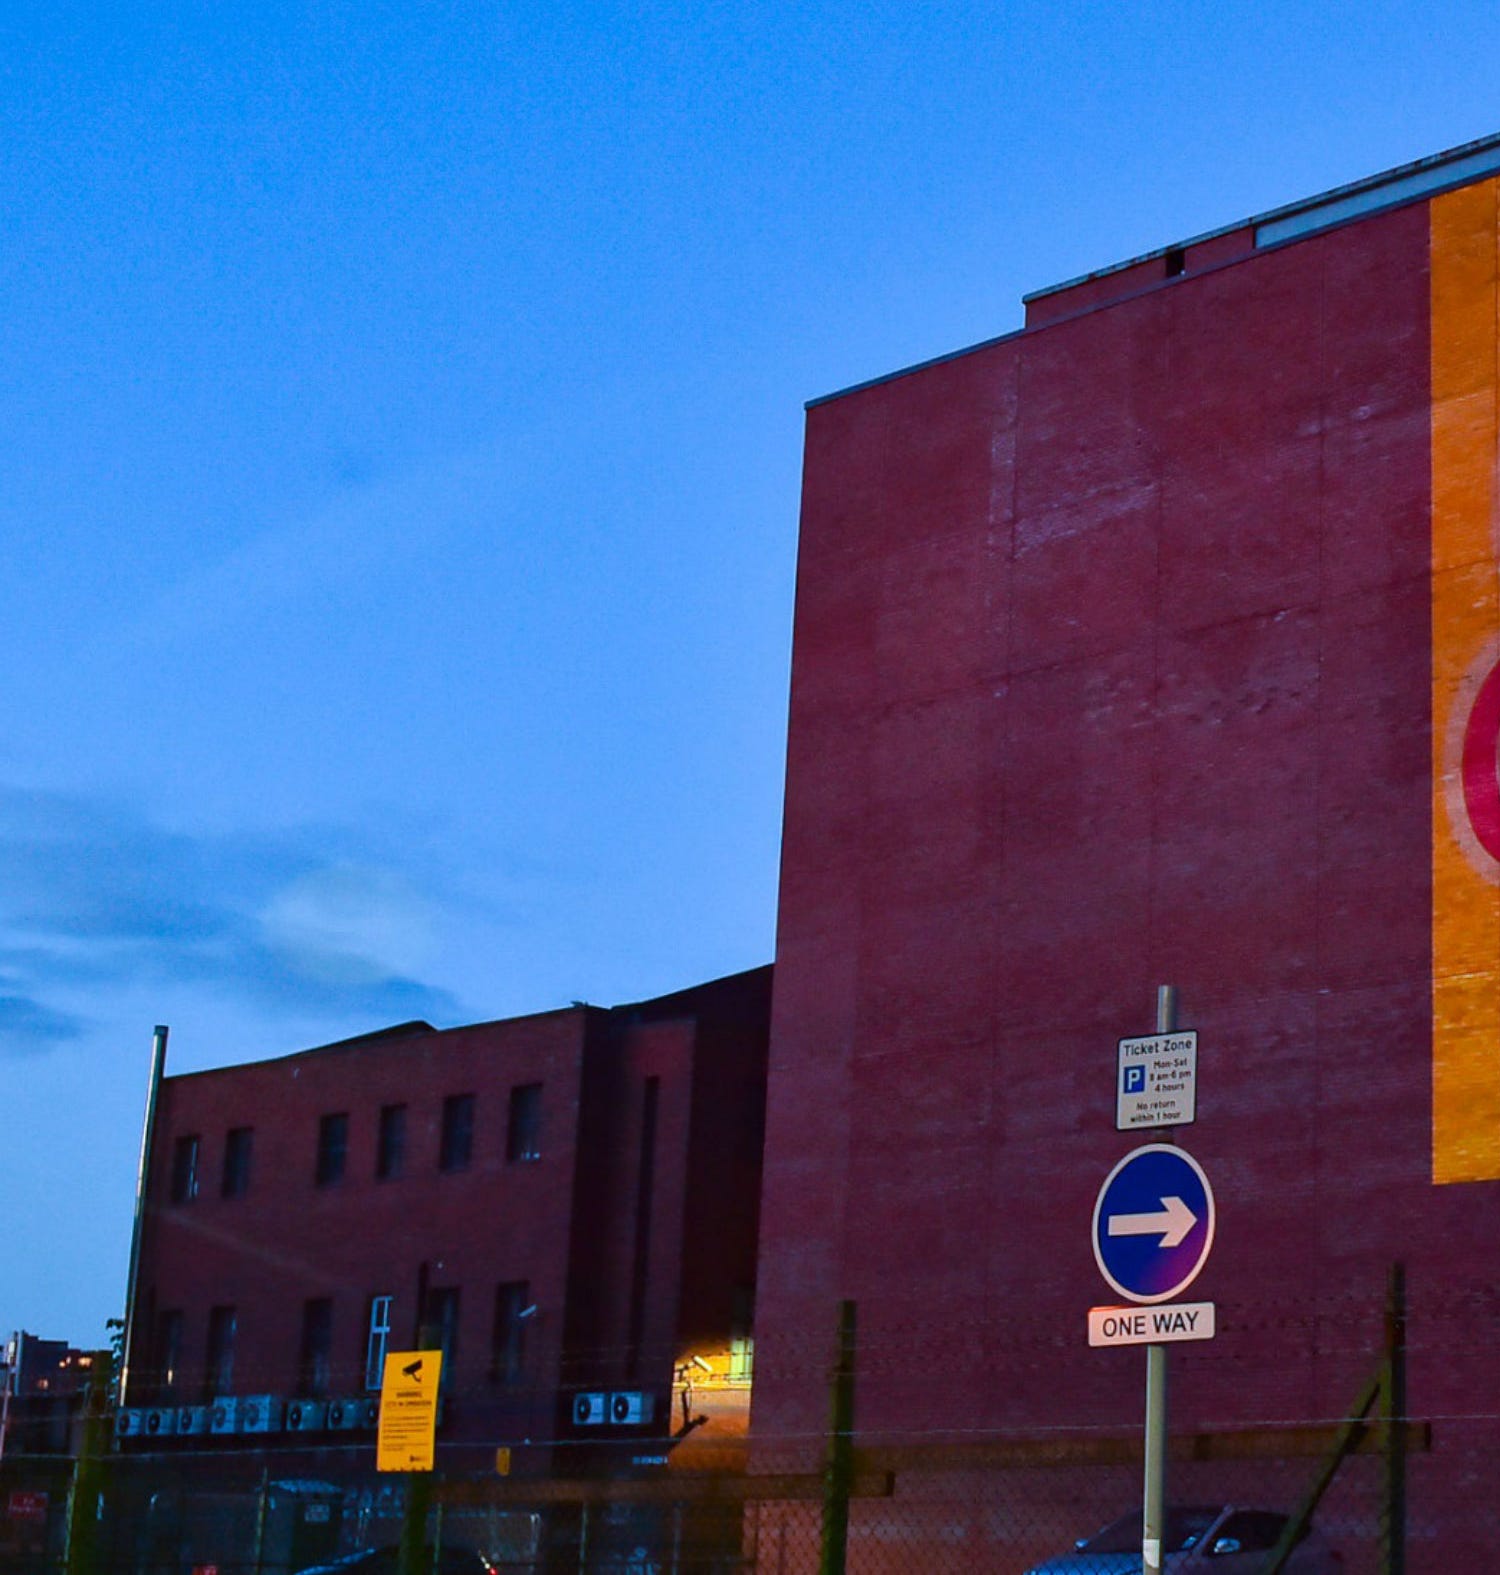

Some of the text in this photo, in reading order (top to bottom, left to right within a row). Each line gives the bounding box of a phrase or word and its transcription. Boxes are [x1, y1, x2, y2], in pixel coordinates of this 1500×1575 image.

[1124, 1039, 1192, 1056] Ticket Zone
[1153, 1058, 1187, 1069] Mon-Sat
[1128, 1070, 1141, 1090] P
[1155, 1082, 1185, 1091] 4 hours
[1136, 1100, 1176, 1110] No return
[1162, 1111, 1181, 1120] hour
[1103, 1312, 1200, 1337] ONE WAY
